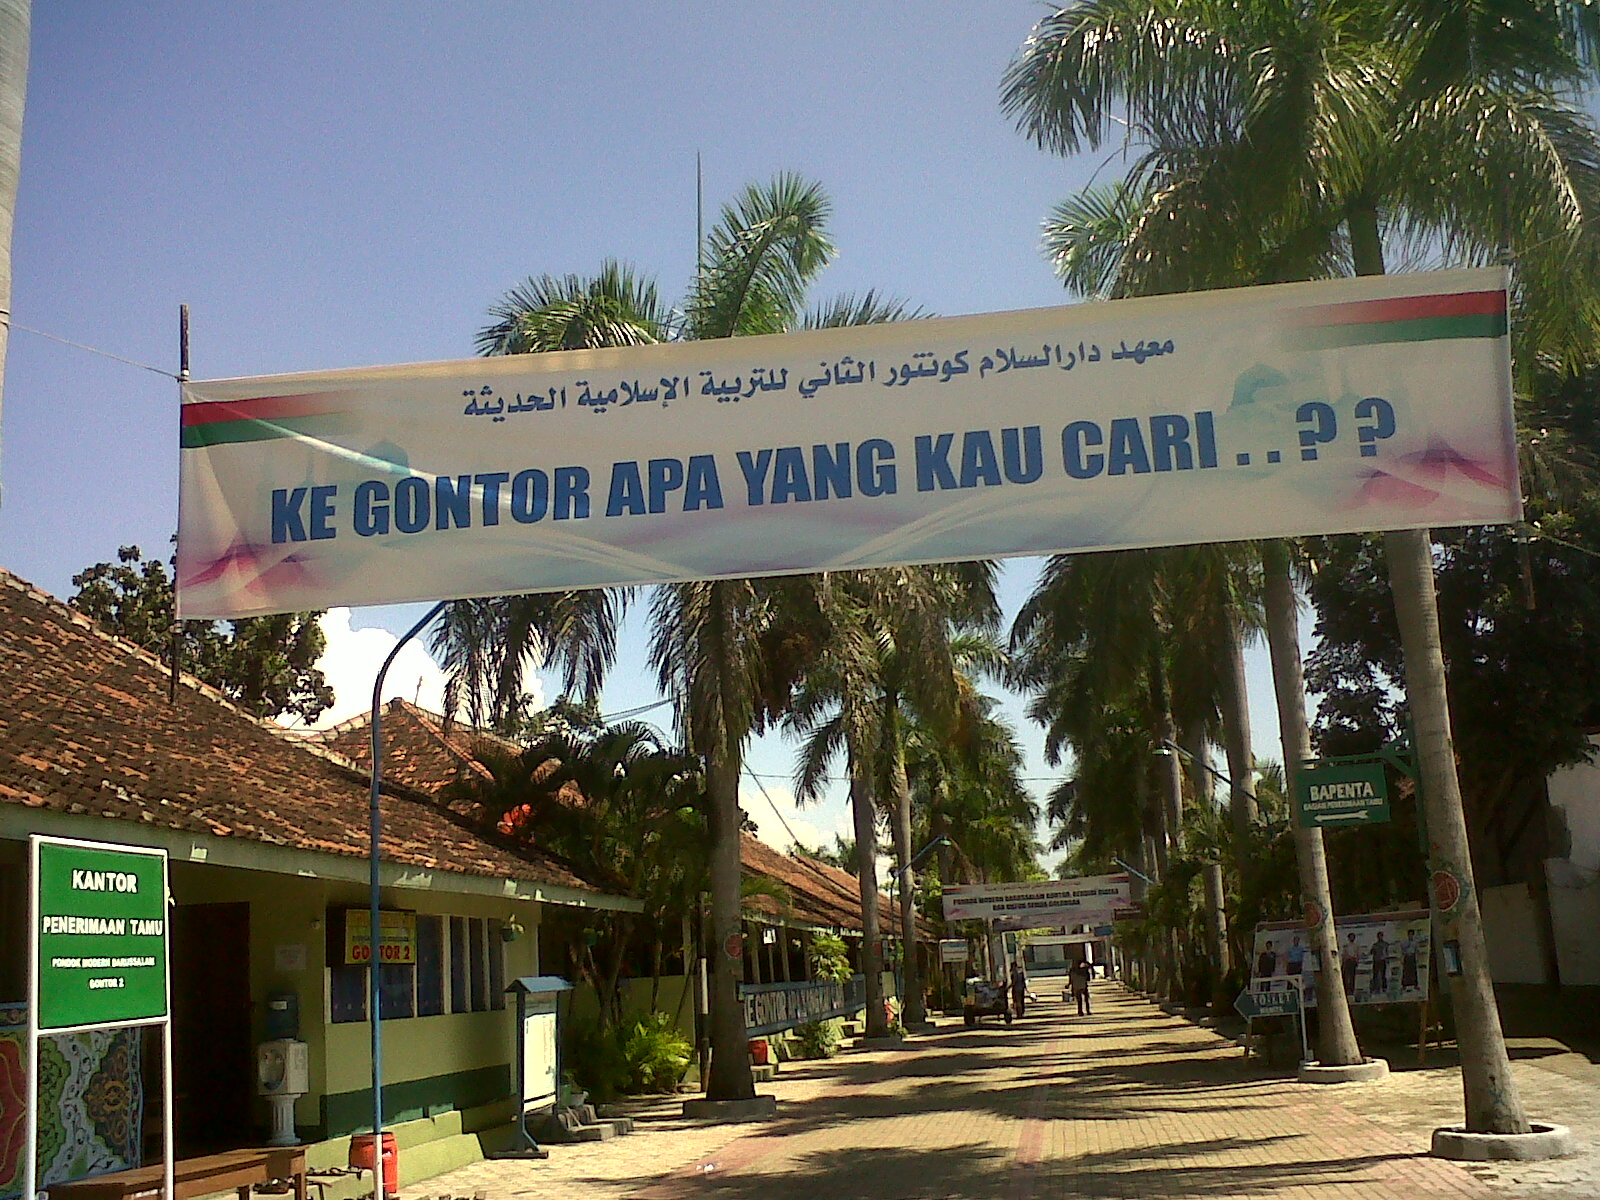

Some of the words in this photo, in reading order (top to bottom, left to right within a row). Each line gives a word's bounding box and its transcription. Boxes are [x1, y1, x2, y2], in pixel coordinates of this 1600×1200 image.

[1111, 339, 1175, 365] معهد
[798, 356, 876, 399] الثاني
[882, 350, 969, 386] كونتور
[698, 368, 789, 404] للتربية
[462, 385, 567, 423] الحديثة
[271, 484, 337, 544] KE
[353, 466, 591, 538] GONTOR
[605, 454, 724, 518] APA
[736, 438, 897, 506] YANG
[914, 425, 1044, 492] KAU
[1061, 411, 1218, 480] CARI
[1310, 782, 1375, 801] BAPENTA
[72, 869, 138, 893] KANTOR
[42, 915, 126, 935] PENERIMAAN
[129, 919, 163, 936] TAMU
[352, 944, 400, 960] GOTOR
[404, 945, 410, 960] 2
[89, 978, 118, 989] GONTOR
[118, 977, 125, 988] 2
